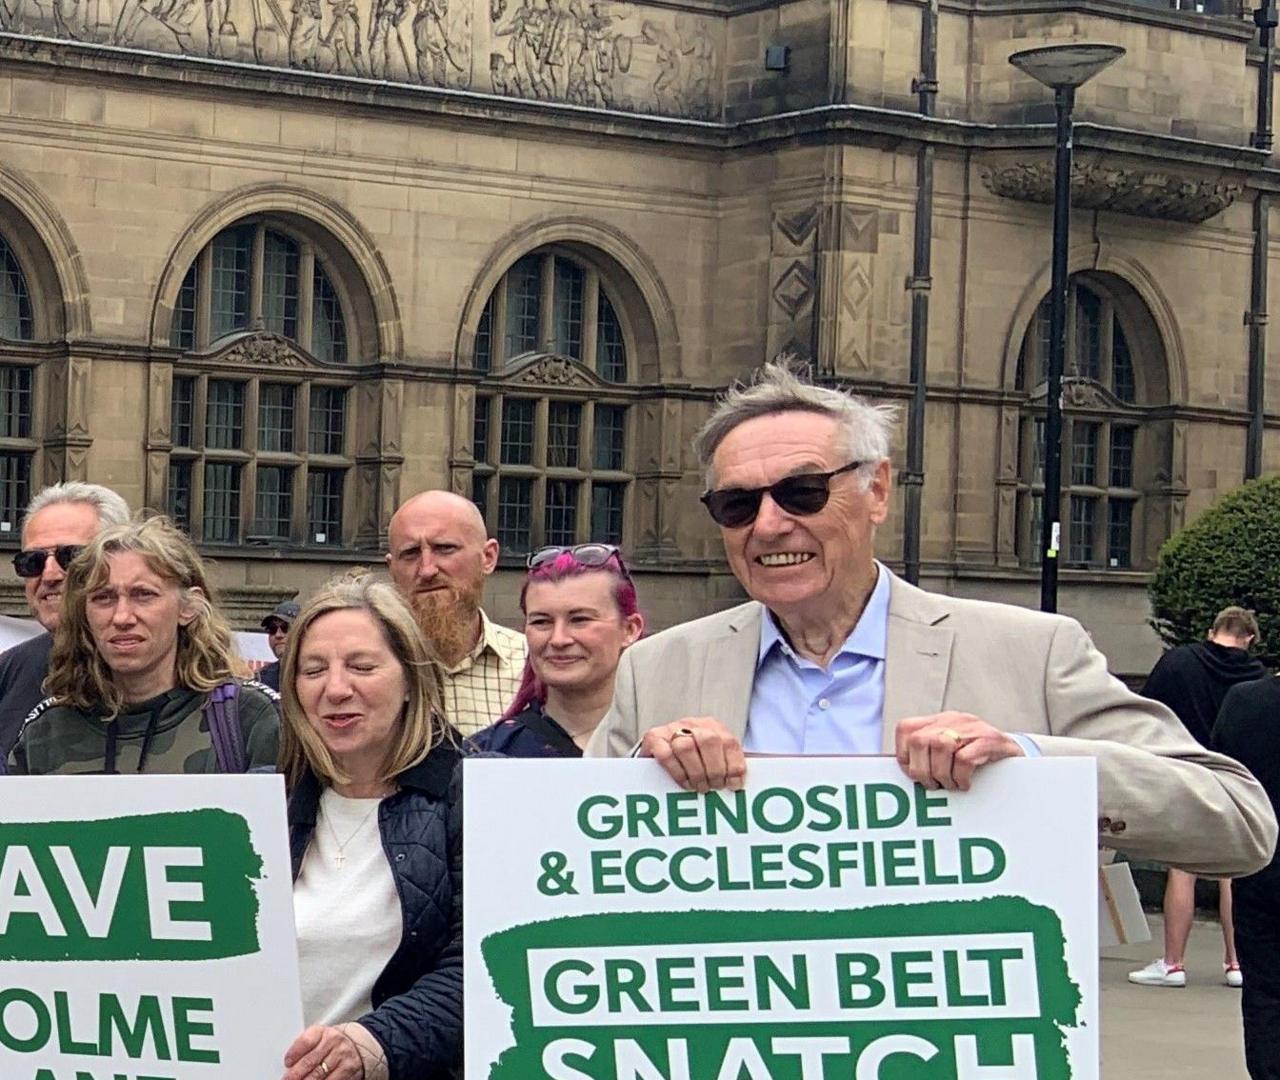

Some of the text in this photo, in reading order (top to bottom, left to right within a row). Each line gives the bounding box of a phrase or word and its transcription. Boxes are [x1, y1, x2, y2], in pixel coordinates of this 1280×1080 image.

[577, 782, 952, 840] GRENOSIDE
[536, 837, 1007, 897] & ECCLESFIELD
[543, 948, 1024, 1014] GREEN BELT
